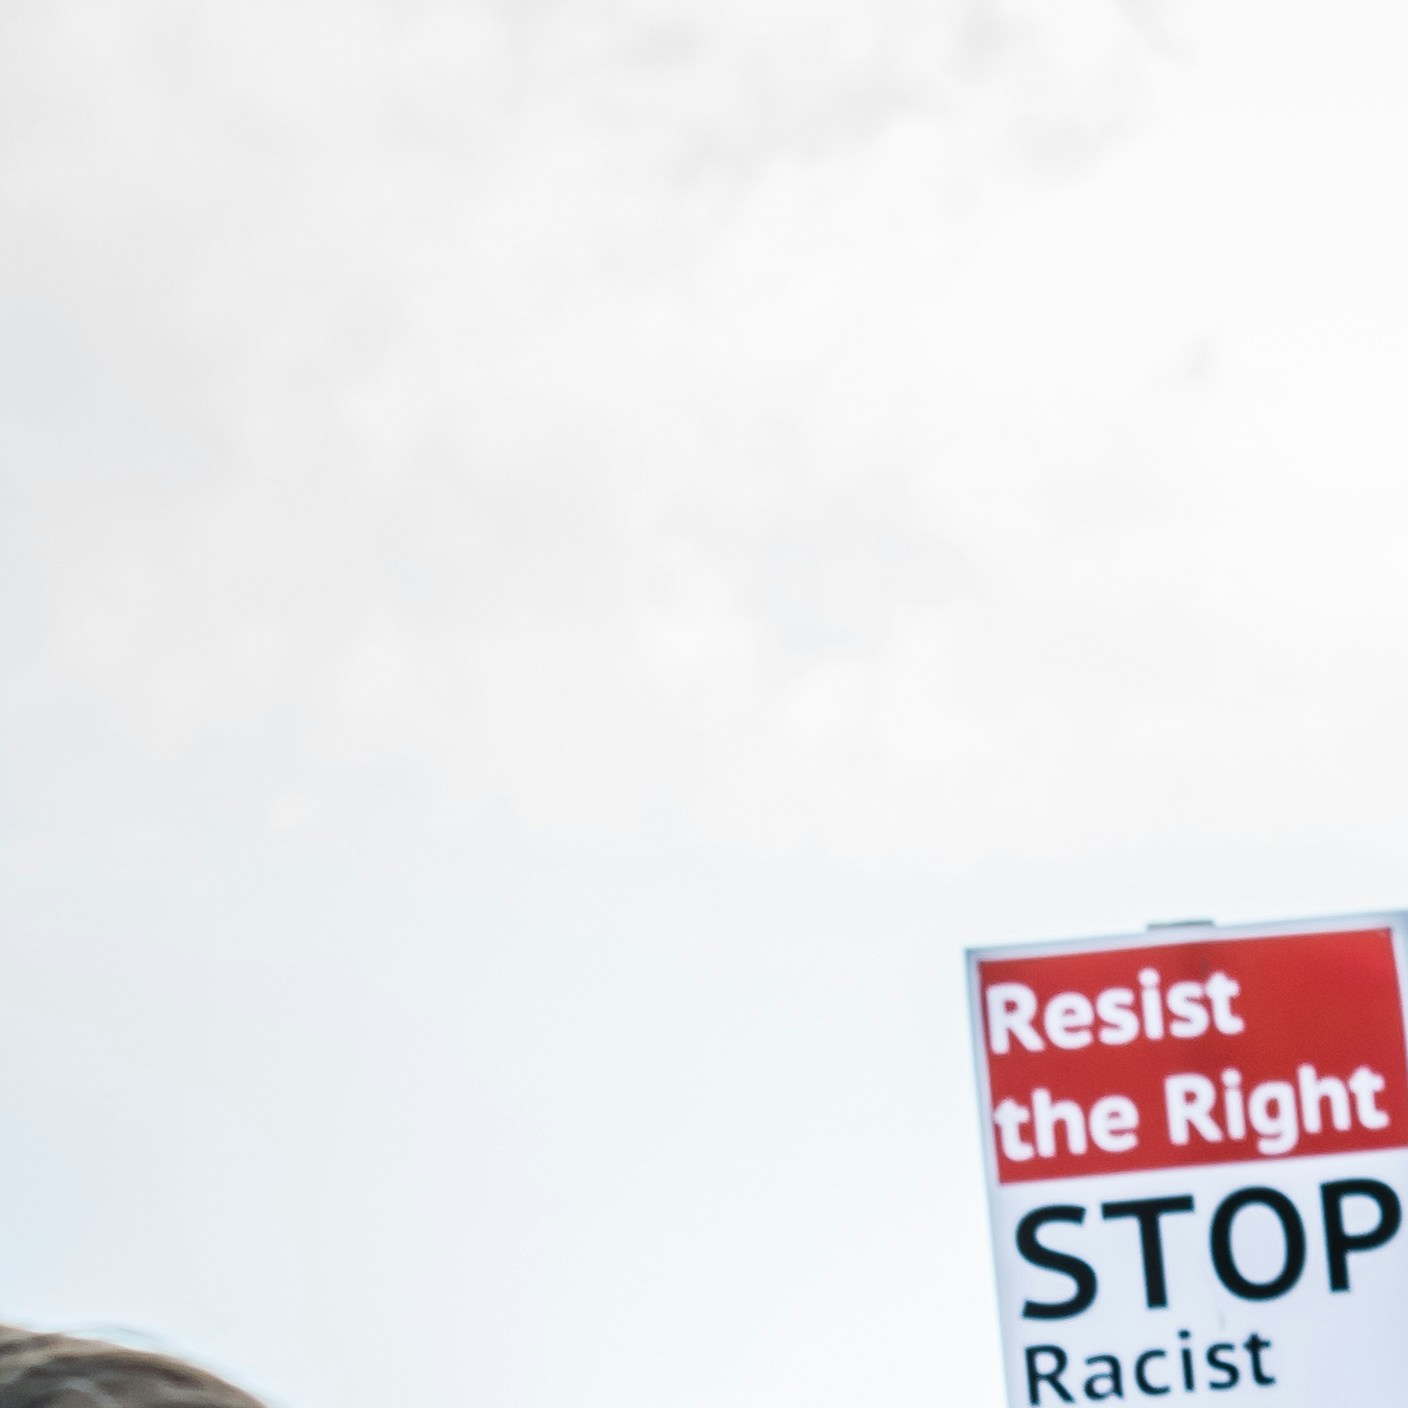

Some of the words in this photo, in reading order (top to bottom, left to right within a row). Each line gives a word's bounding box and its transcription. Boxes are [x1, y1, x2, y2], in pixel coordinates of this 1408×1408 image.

[984, 968, 1244, 1055] Resist
[995, 1088, 1139, 1162] the
[1164, 1065, 1390, 1157] Right
[1015, 1177, 1403, 1321] STOP
[1025, 1329, 1276, 1406] Racist
